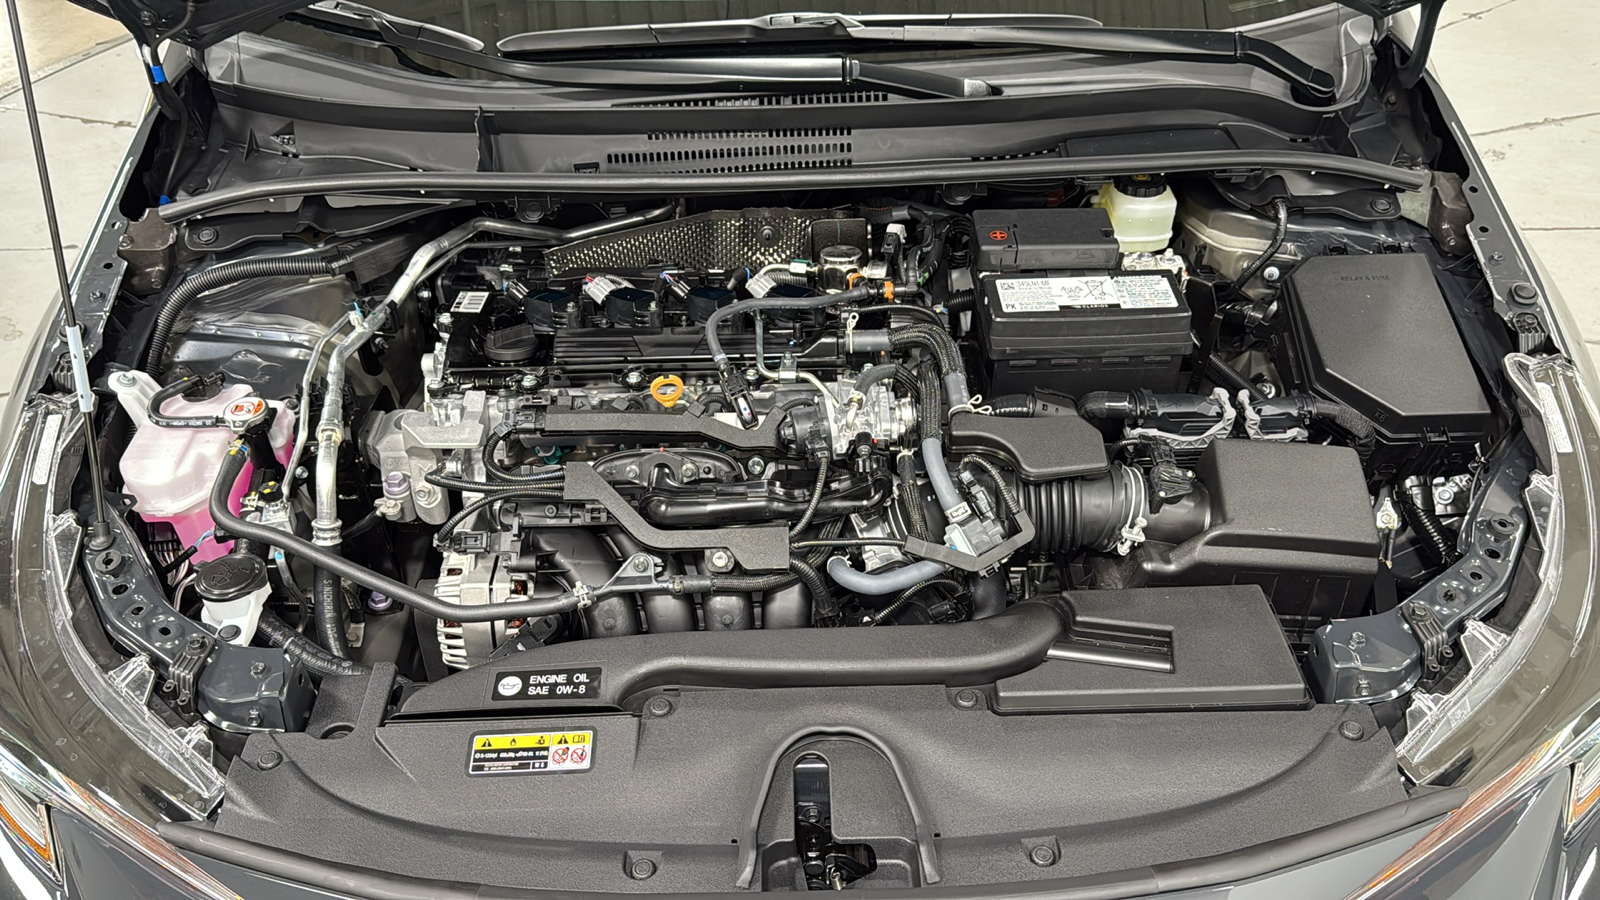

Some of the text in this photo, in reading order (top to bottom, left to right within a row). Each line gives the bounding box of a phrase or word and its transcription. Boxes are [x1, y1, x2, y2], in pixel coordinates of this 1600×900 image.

[529, 673, 590, 685] ENGINE OIL
[527, 684, 586, 695] SAE 0W-8
